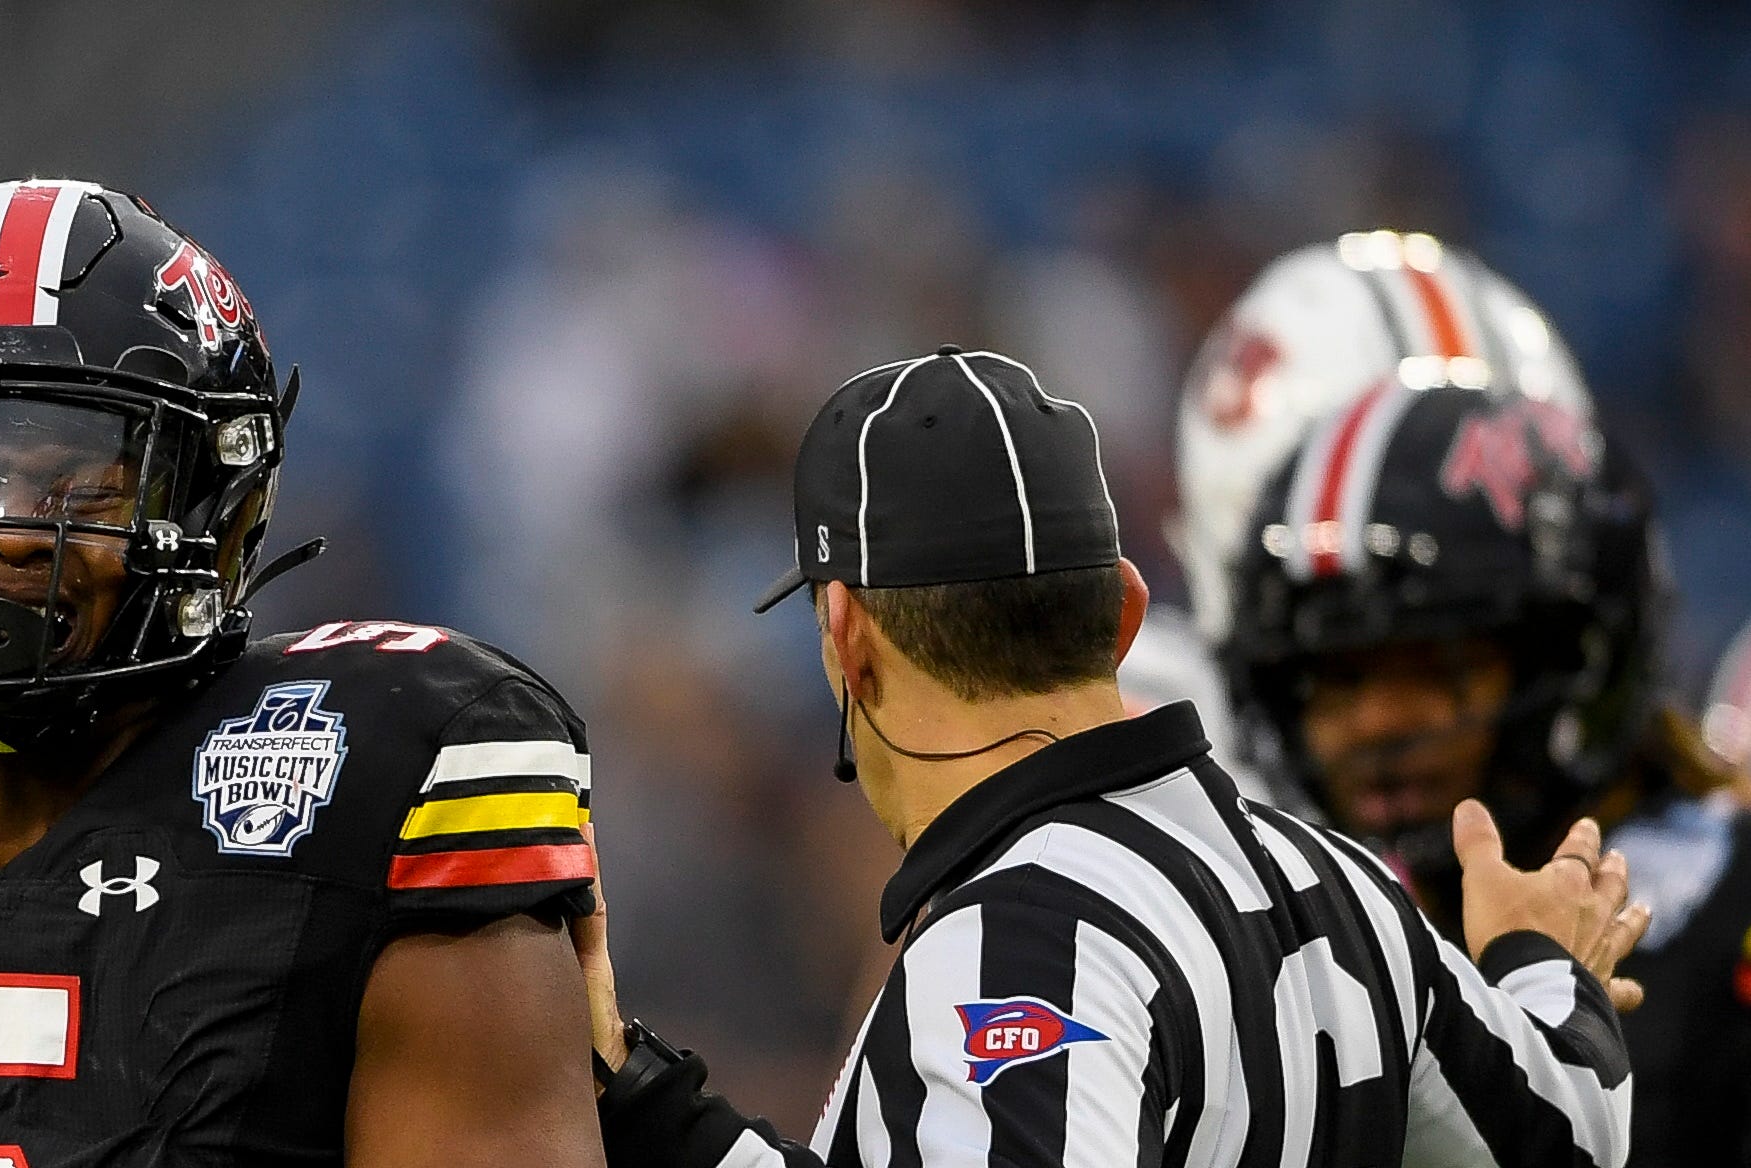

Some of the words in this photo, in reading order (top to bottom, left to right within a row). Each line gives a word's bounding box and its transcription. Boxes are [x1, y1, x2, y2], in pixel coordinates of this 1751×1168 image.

[212, 736, 334, 751] TRANSPERFECT
[203, 755, 274, 787] MUSIC
[275, 756, 332, 790] CITY
[226, 780, 296, 808] BOWL
[985, 1027, 1040, 1051] CFO
